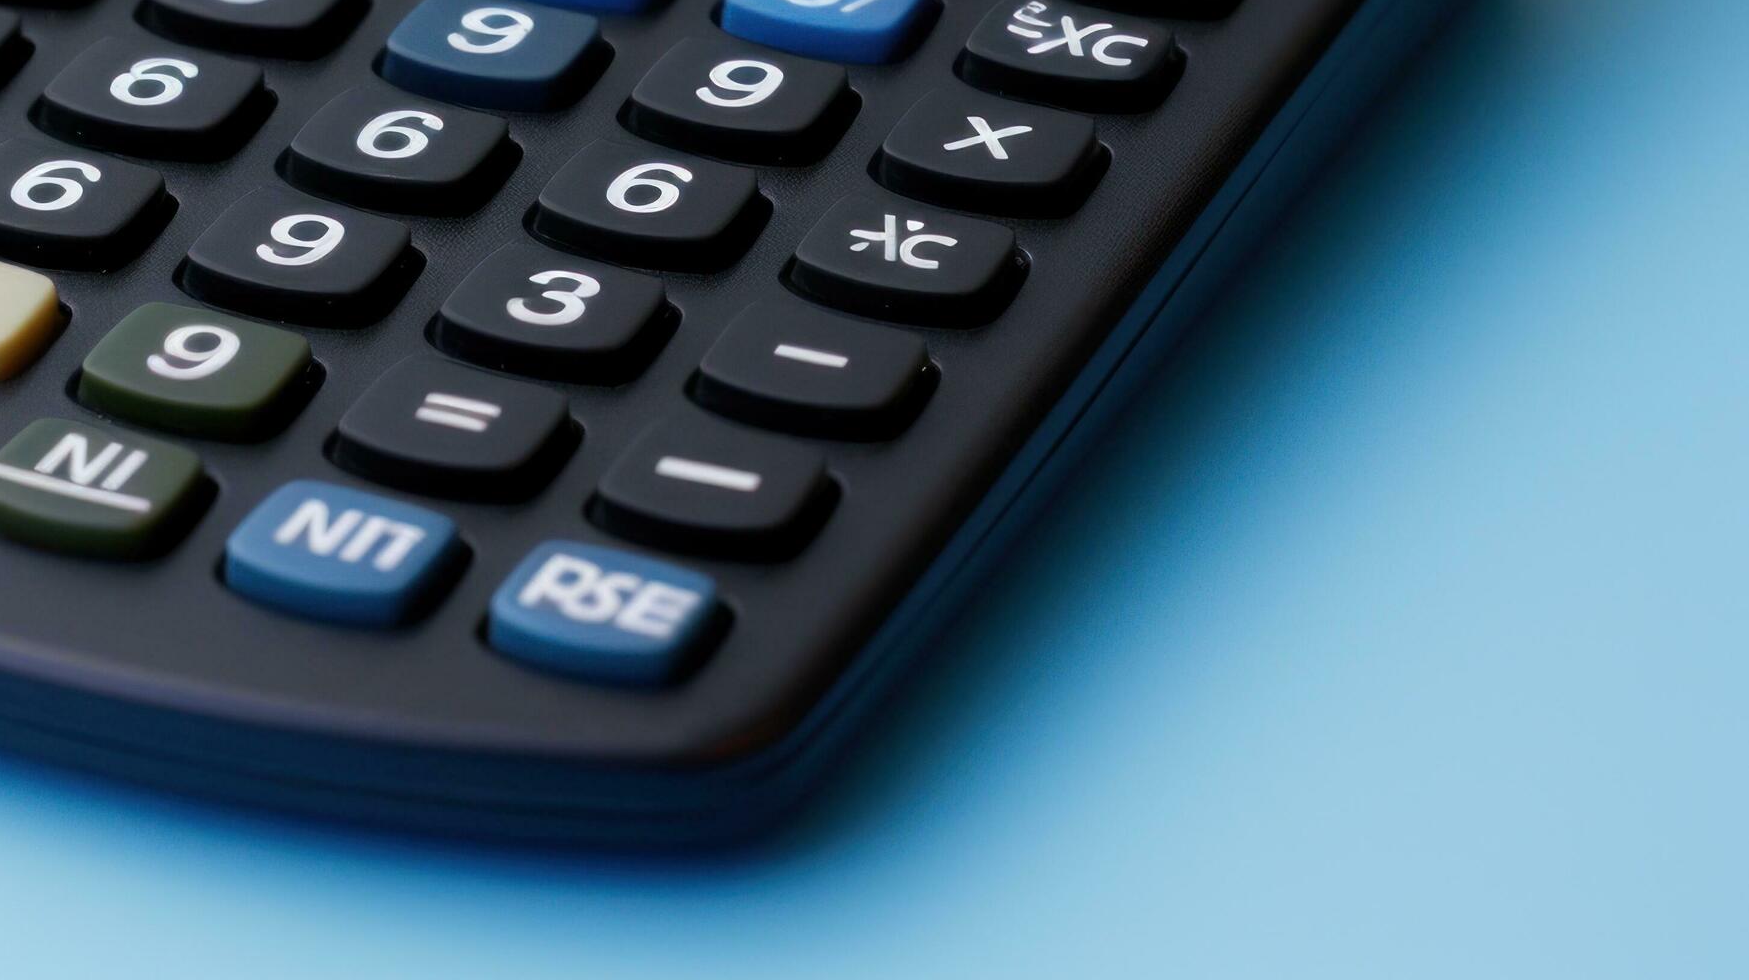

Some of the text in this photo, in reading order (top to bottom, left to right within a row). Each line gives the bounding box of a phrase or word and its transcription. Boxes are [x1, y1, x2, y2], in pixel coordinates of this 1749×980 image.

[447, 7, 534, 54] 9
[109, 57, 199, 106] 6
[695, 59, 784, 108] 9
[356, 109, 444, 159] 6
[10, 159, 102, 211] 6
[606, 162, 693, 214] 6
[255, 213, 345, 266] 9
[506, 270, 601, 326] 3
[146, 324, 241, 380] 9
